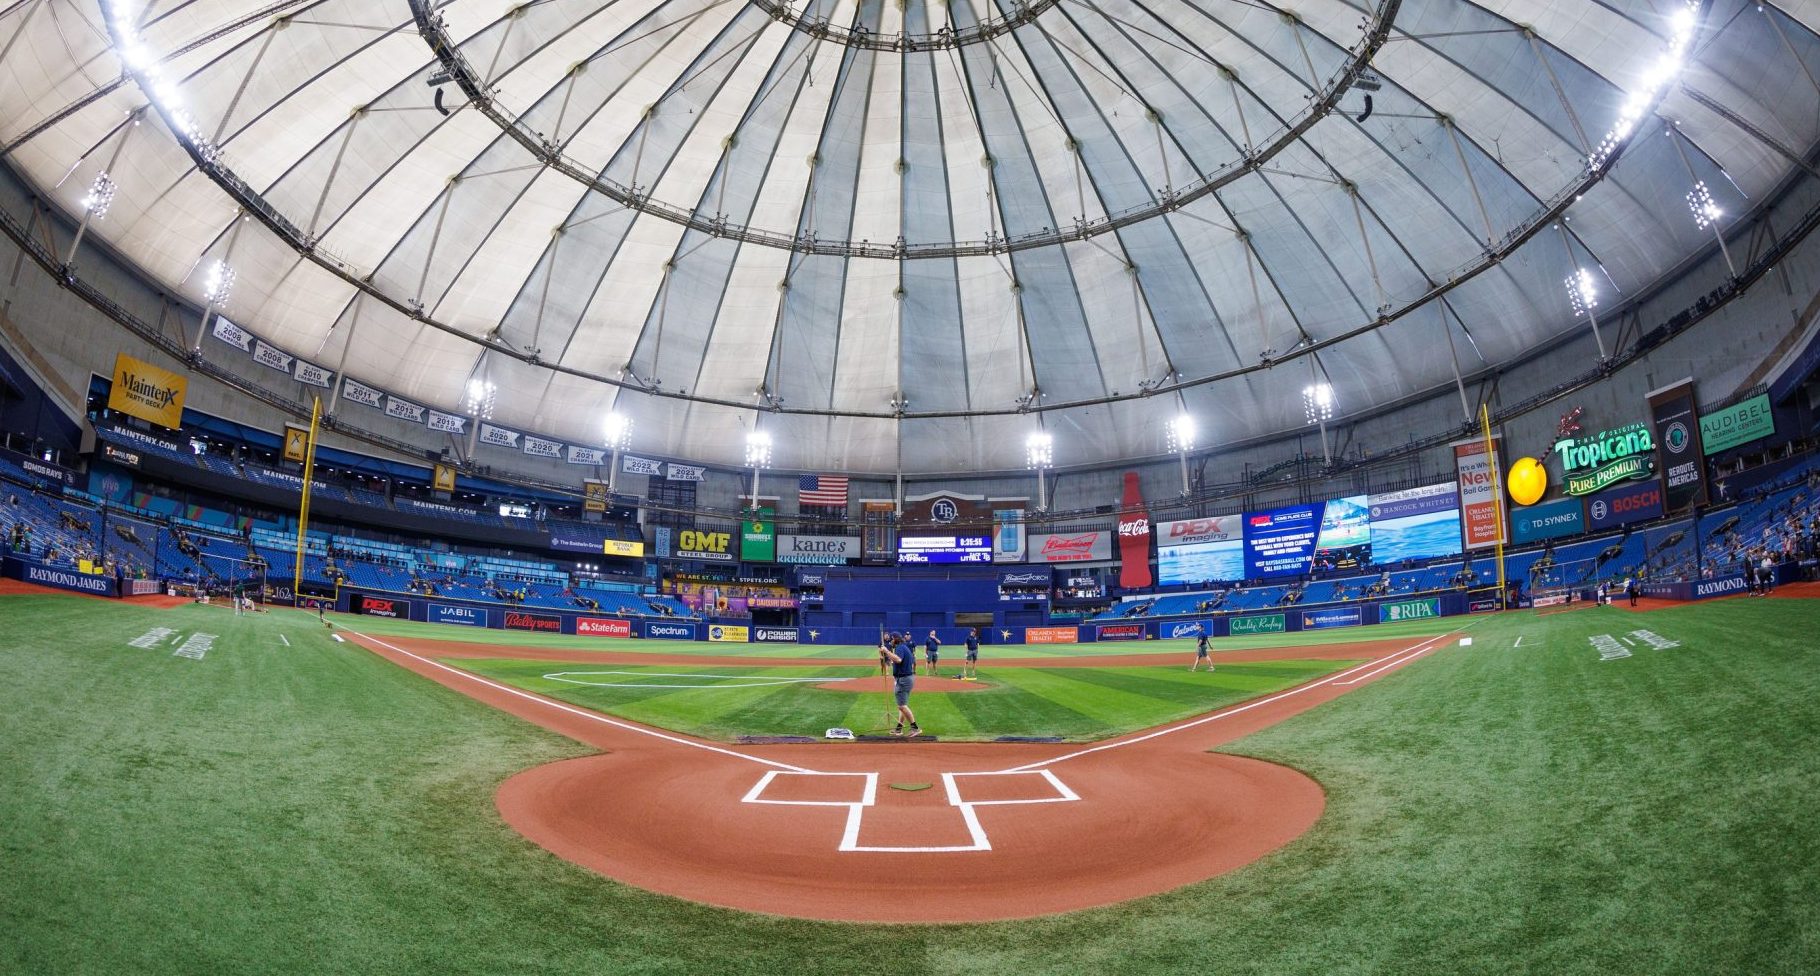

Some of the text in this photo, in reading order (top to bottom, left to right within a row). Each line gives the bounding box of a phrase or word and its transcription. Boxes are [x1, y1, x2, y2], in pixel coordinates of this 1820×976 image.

[216, 330, 245, 349] CHAMPIONS
[223, 327, 242, 342] 2008
[257, 342, 275, 354] AMERICAN
[256, 355, 286, 371] CHAMPIONS
[262, 349, 282, 364] 2008
[297, 374, 325, 386] CHAMPIONS
[303, 369, 321, 380] 2010
[346, 381, 364, 391] AMERICAN
[126, 392, 161, 409] PARTY DECK
[346, 392, 376, 406] WILD CARD
[353, 388, 371, 399] 2011
[388, 398, 407, 407] AMERICAN
[395, 404, 413, 415] 2013
[403, 413, 418, 421] CARD
[430, 412, 448, 420] AMERICAN
[436, 418, 456, 427] 2019
[1703, 403, 1769, 434] AUDIBEL
[445, 425, 460, 433] CARD
[489, 431, 508, 441] 2020
[1577, 422, 1645, 444] THE ORIGINAL
[1712, 427, 1735, 440] HEARING
[1738, 418, 1763, 430] CENTERS
[114, 425, 177, 451] MAINTENX.COM
[483, 436, 513, 446] CHAMPIONS
[526, 447, 557, 457] CHAMPIONS
[532, 442, 553, 452] 2020
[1555, 429, 1651, 470] Tropicana
[570, 457, 600, 465] CHAMPIONS
[575, 451, 594, 459] 2021
[23, 461, 62, 479] SOMOS RAYS
[632, 461, 652, 470] 2022
[676, 468, 695, 476] 2023
[1668, 462, 1694, 477] REROUTE
[1461, 471, 1497, 486] New
[1570, 459, 1642, 492] PURE PREMIUM
[1669, 471, 1698, 488] AMERICAS
[1464, 487, 1476, 496] Ball
[1383, 498, 1454, 514] HANCOCK WHITNEY
[1613, 491, 1660, 513] BOSCH
[936, 503, 953, 518] TB
[1532, 512, 1577, 528] TD SYNNEX
[1170, 518, 1223, 537] DEX
[680, 531, 730, 552] GMF
[1183, 533, 1228, 542] imaging
[30, 568, 106, 591] RAYMOND JAMES
[1698, 578, 1742, 595] RAYMOND
[362, 599, 394, 611] DEX
[1401, 602, 1432, 618] RIPA
[441, 608, 475, 617] JABIL
[506, 613, 559, 632] Bally SPORTS
[1103, 625, 1138, 634] AMERICAN
[1233, 617, 1282, 632] Quality Roofing
[651, 626, 688, 635] Spectrum
